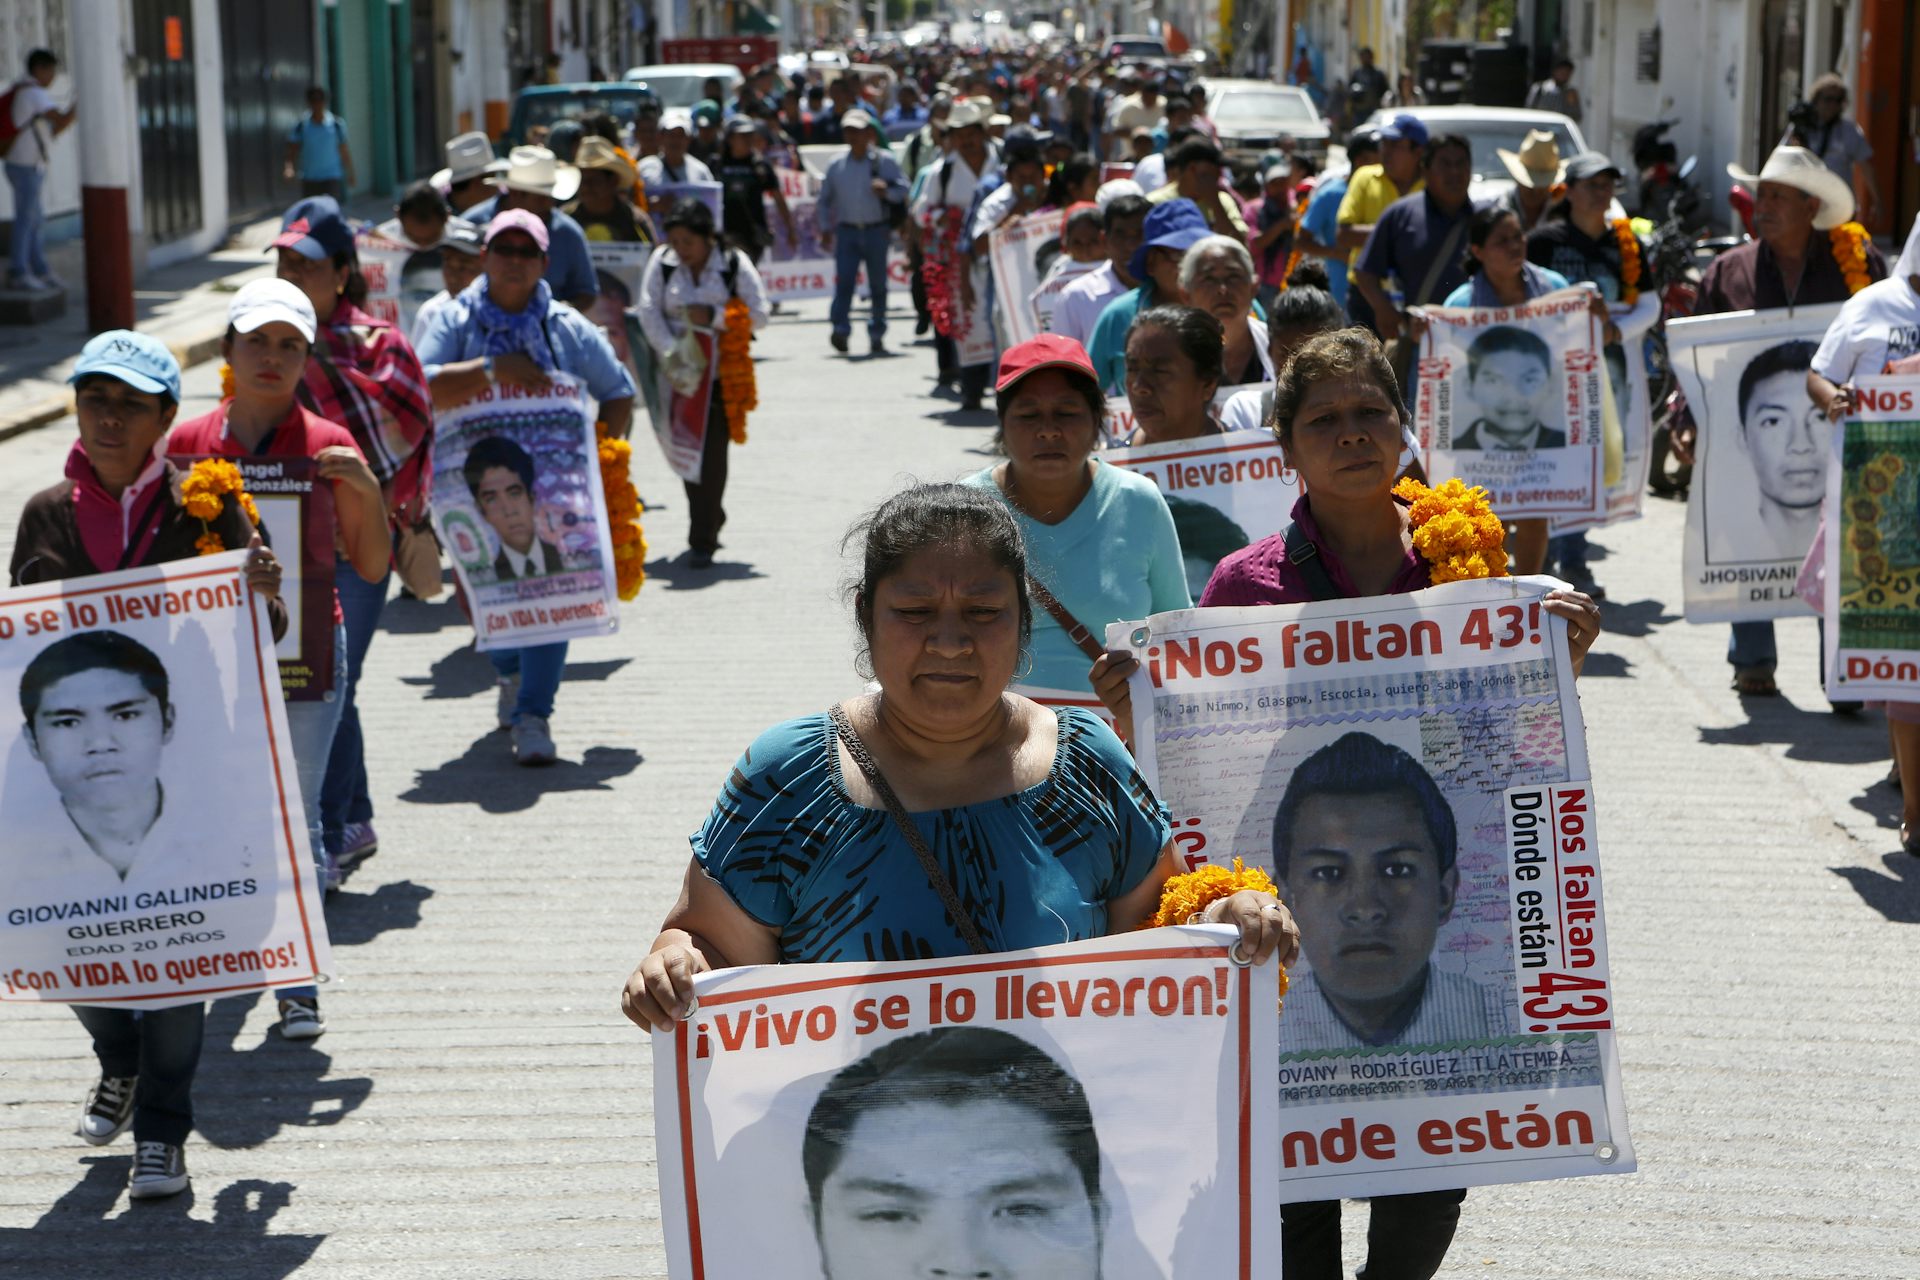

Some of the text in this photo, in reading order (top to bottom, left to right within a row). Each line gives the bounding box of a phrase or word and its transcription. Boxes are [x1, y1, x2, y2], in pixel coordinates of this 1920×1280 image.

[24, 609, 59, 636] se
[65, 601, 98, 629] lo
[103, 578, 243, 623] llevaron!
[1750, 587, 1774, 602] DE
[1148, 602, 1542, 688] ¡Nos faltan 43!
[1179, 704, 1200, 715] Jan
[1206, 701, 1249, 714] Nimmo,
[1257, 694, 1313, 709] Glasgow,
[1320, 687, 1378, 702] Escocia,
[1385, 682, 1430, 698] quiero
[1437, 678, 1474, 691] saber
[1510, 791, 1547, 881] Dónde
[8, 878, 258, 927] GIOVANNI GALINDES
[1557, 788, 1597, 969] Nos faltan
[66, 929, 227, 957] EDAD 20 AÑOS
[67, 910, 206, 940] GUERRERO
[1516, 890, 1555, 969] están
[3, 941, 298, 995] ¡Con VIDA lo queremos!
[696, 966, 1229, 1058] ¡Vivo se lo llevaron!
[1522, 972, 1611, 1033] 43!
[1350, 1057, 1460, 1080] RODRÍGUEZ
[1471, 1050, 1574, 1072] TLATEMPA
[1417, 1103, 1594, 1156] están
